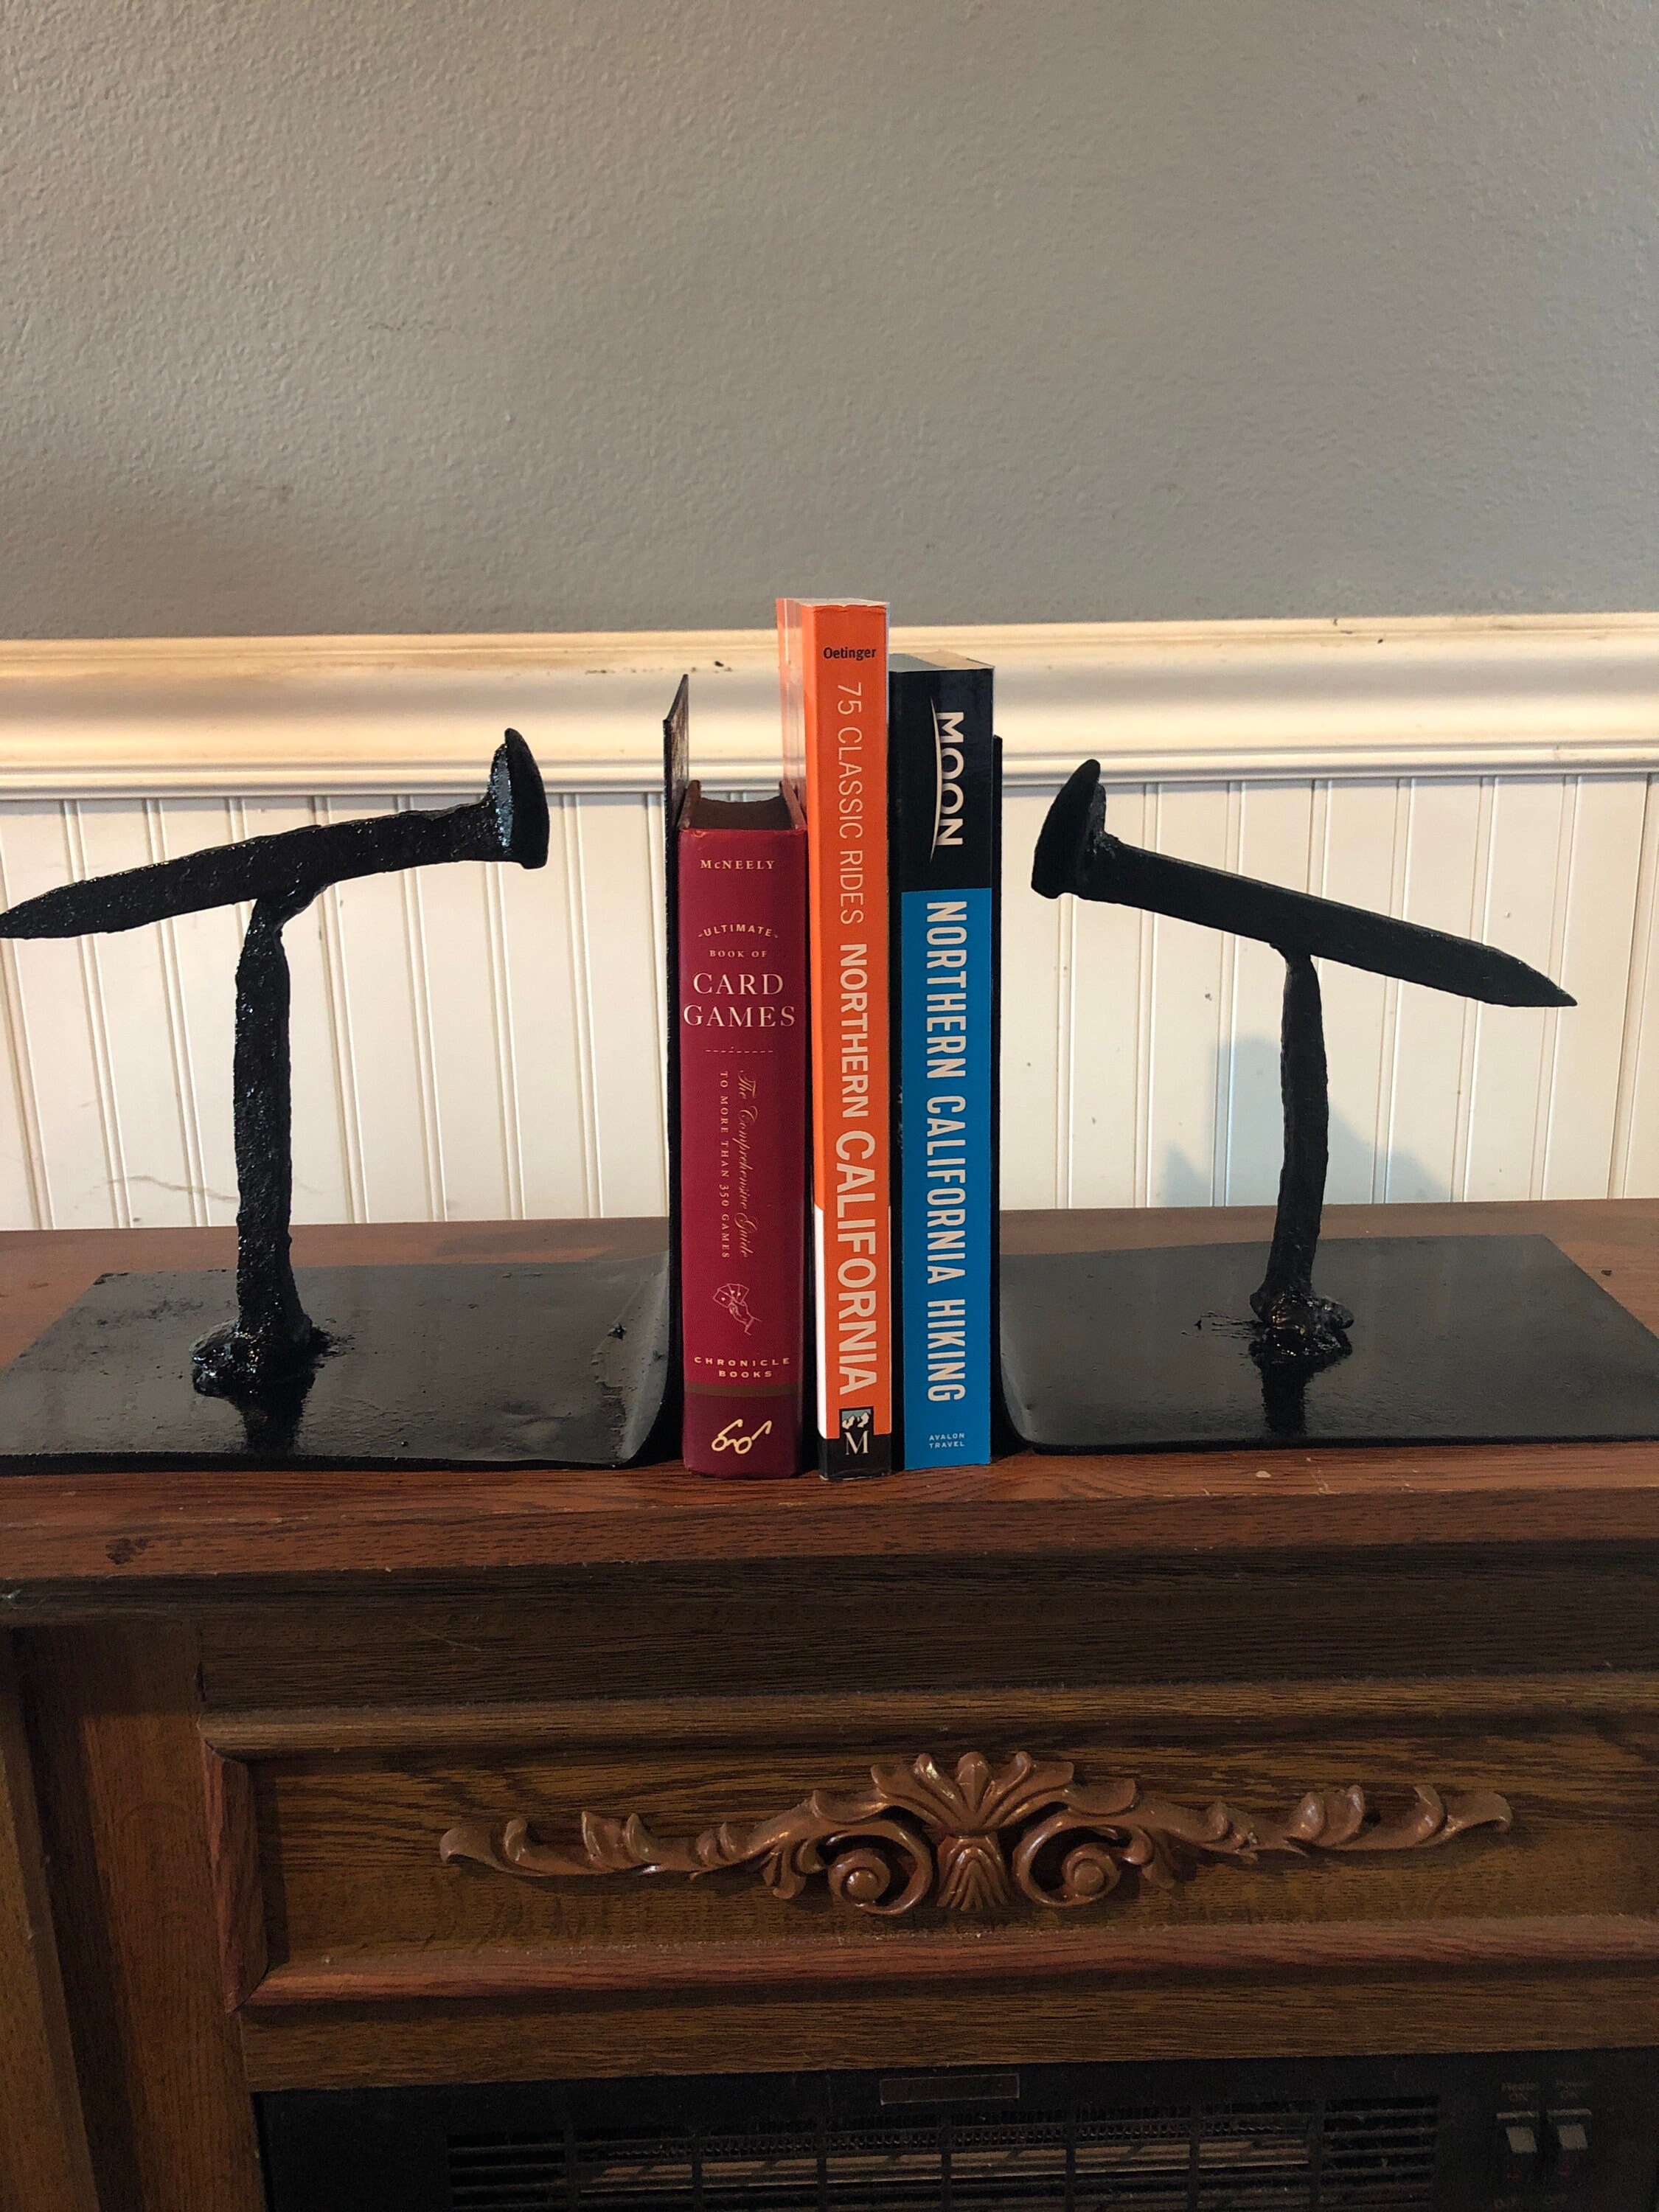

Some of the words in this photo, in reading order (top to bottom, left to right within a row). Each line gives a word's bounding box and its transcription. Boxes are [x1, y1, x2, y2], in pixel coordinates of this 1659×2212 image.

[823, 647, 877, 661] Oetinger
[837, 682, 862, 715] 75
[837, 726, 863, 840] CLASSIC
[935, 712, 964, 846] MOON
[840, 850, 864, 925] RIDES
[709, 950, 745, 958] BOOK
[693, 973, 784, 995] CARD
[926, 901, 967, 1079] NORTHERN
[684, 1005, 796, 1028] GAMES
[840, 943, 869, 1118] NORTHERN
[720, 1071, 728, 1088] TO
[738, 1070, 756, 1099] The
[720, 1096, 729, 1133] MORE
[720, 1141, 729, 1178] THAN
[732, 1105, 758, 1209] Comprehensive
[719, 1184, 729, 1207] 350
[926, 1096, 966, 1284] CALIFORNIA
[721, 1214, 730, 1258] GAMES
[734, 1211, 758, 1257] Guide
[835, 1130, 877, 1395] CALIFORNIA
[694, 1357, 790, 1366] CHRONICLE
[927, 1298, 965, 1402] HIKING
[719, 1370, 772, 1378] BOOKS
[845, 1430, 870, 1455] M
[928, 1433, 965, 1441] AVALON
[928, 1441, 965, 1449] TRAVEL
